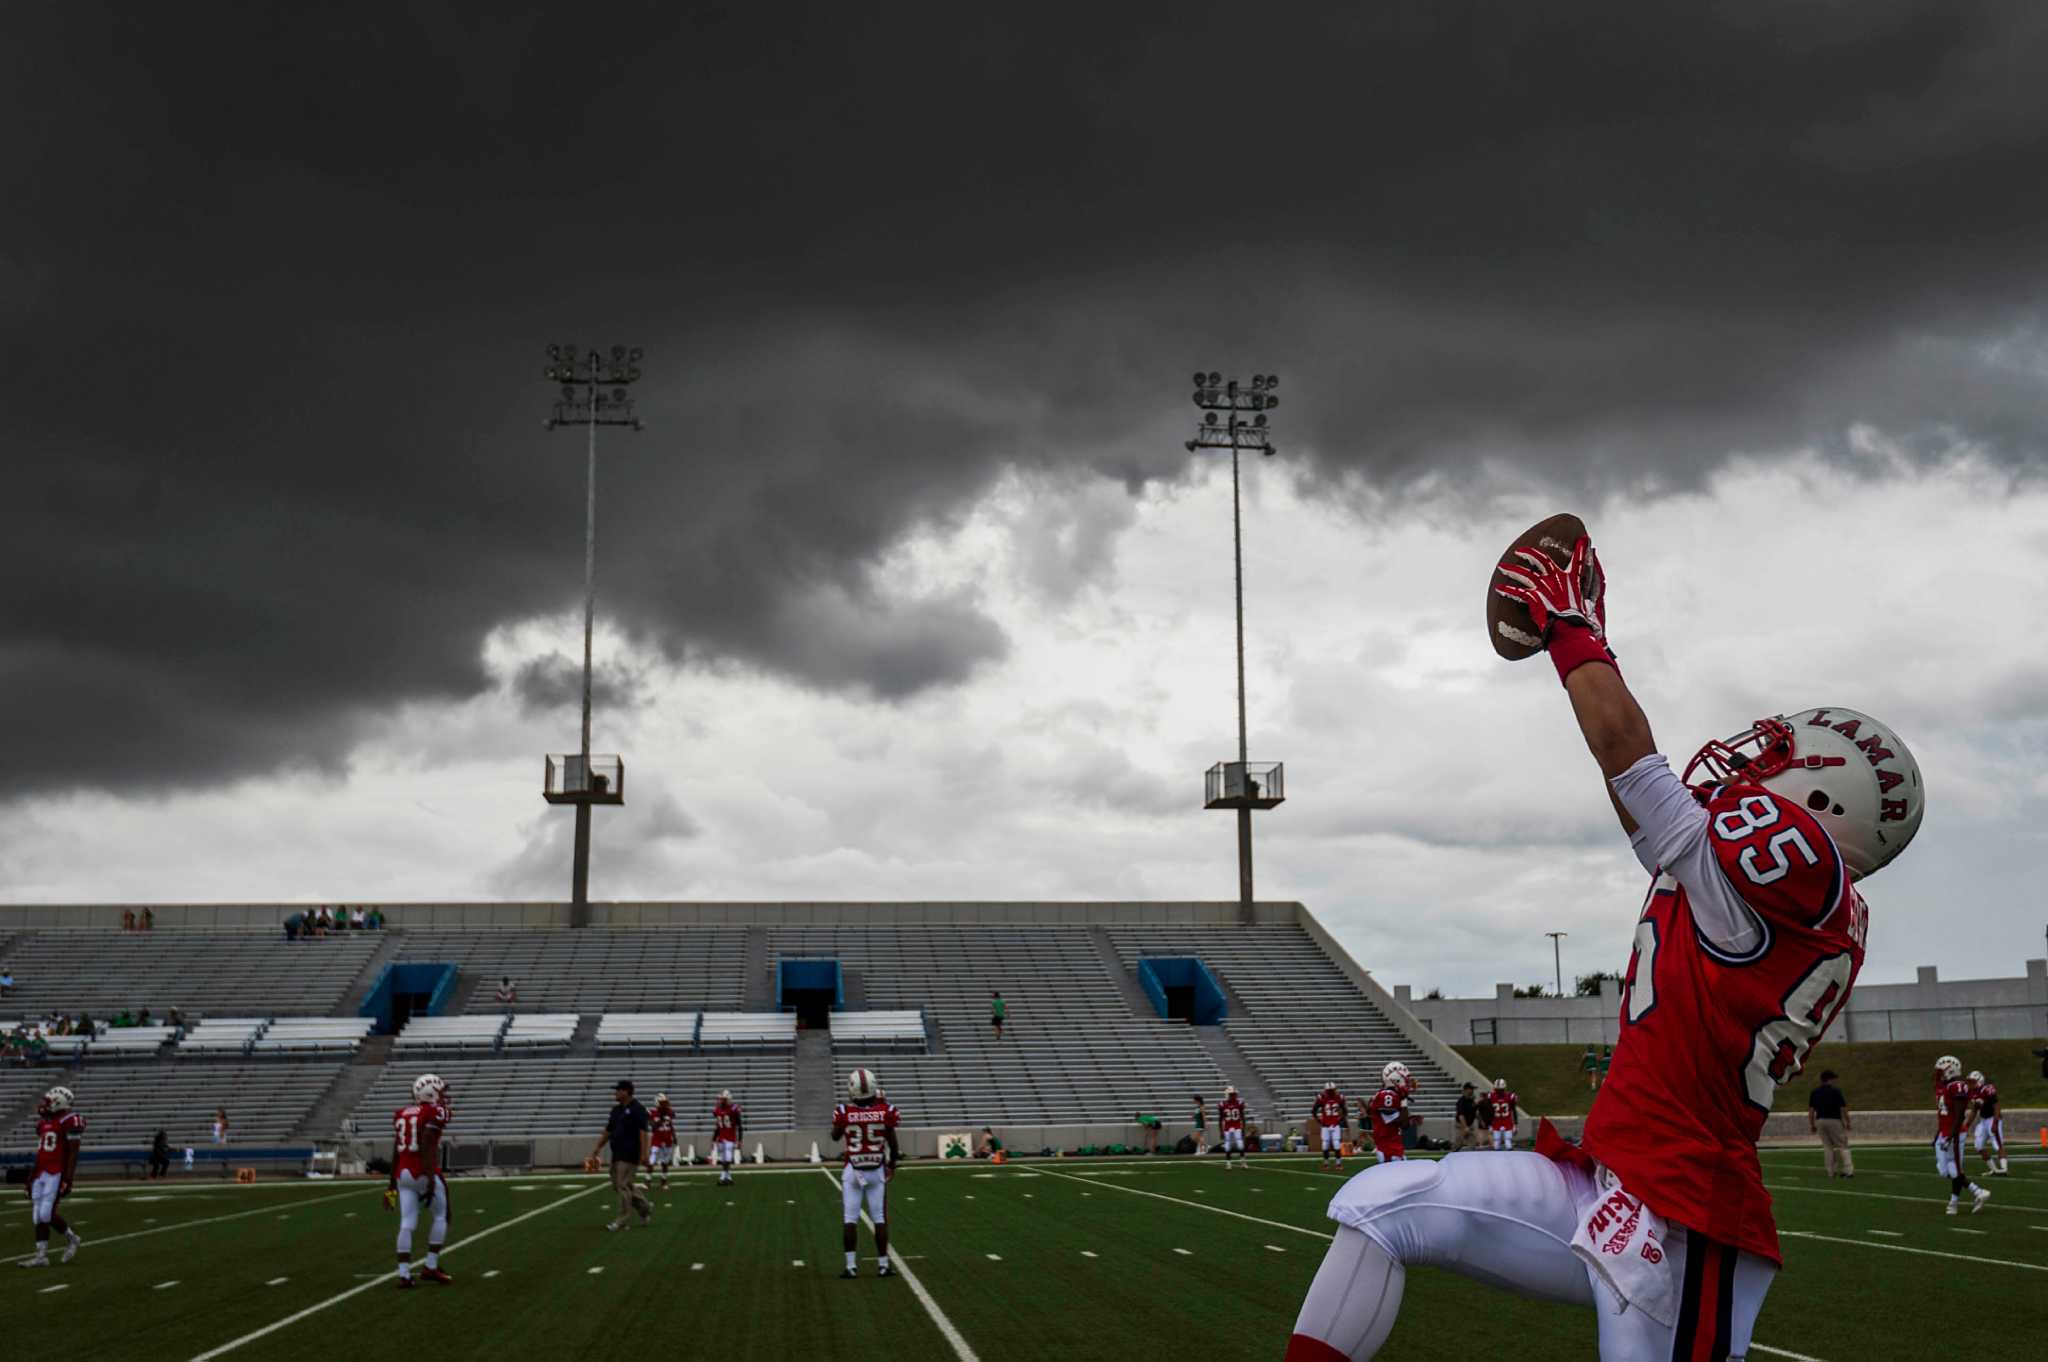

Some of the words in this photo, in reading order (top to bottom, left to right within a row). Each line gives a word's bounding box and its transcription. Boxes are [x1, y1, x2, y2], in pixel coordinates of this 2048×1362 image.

[1808, 710, 1908, 823] LAMAR
[1713, 795, 1819, 886] 85
[395, 1115, 419, 1152] 31
[845, 1123, 887, 1153] 35
